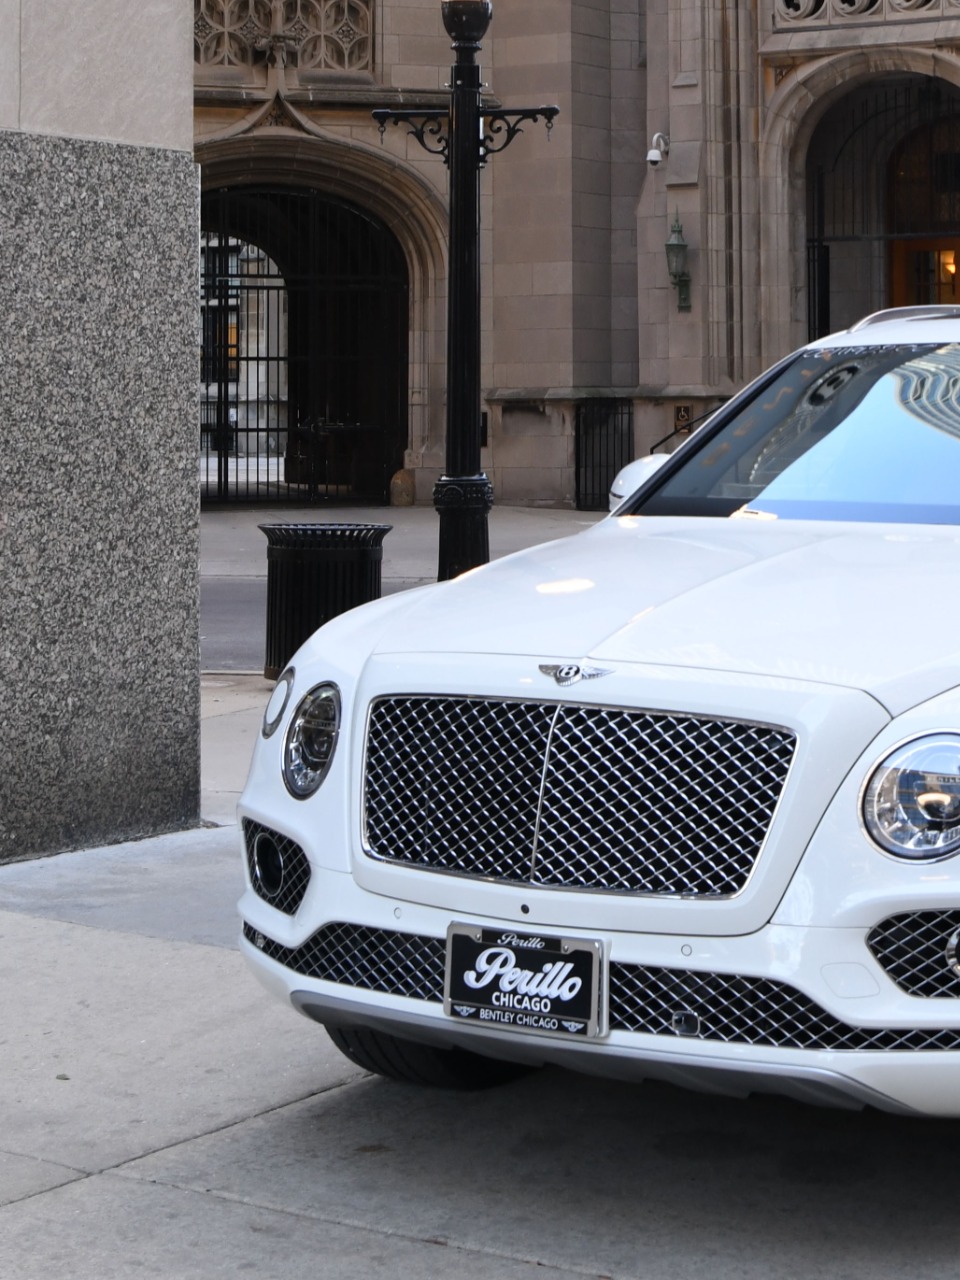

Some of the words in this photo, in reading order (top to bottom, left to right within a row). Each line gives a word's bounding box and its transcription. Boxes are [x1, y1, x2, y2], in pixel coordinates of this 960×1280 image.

[497, 932, 546, 950] Perillo
[463, 946, 583, 1002] Perillo
[491, 991, 551, 1013] CHICAGO
[479, 1008, 515, 1023] BENTLEY
[516, 1013, 559, 1030] CHICAGO
